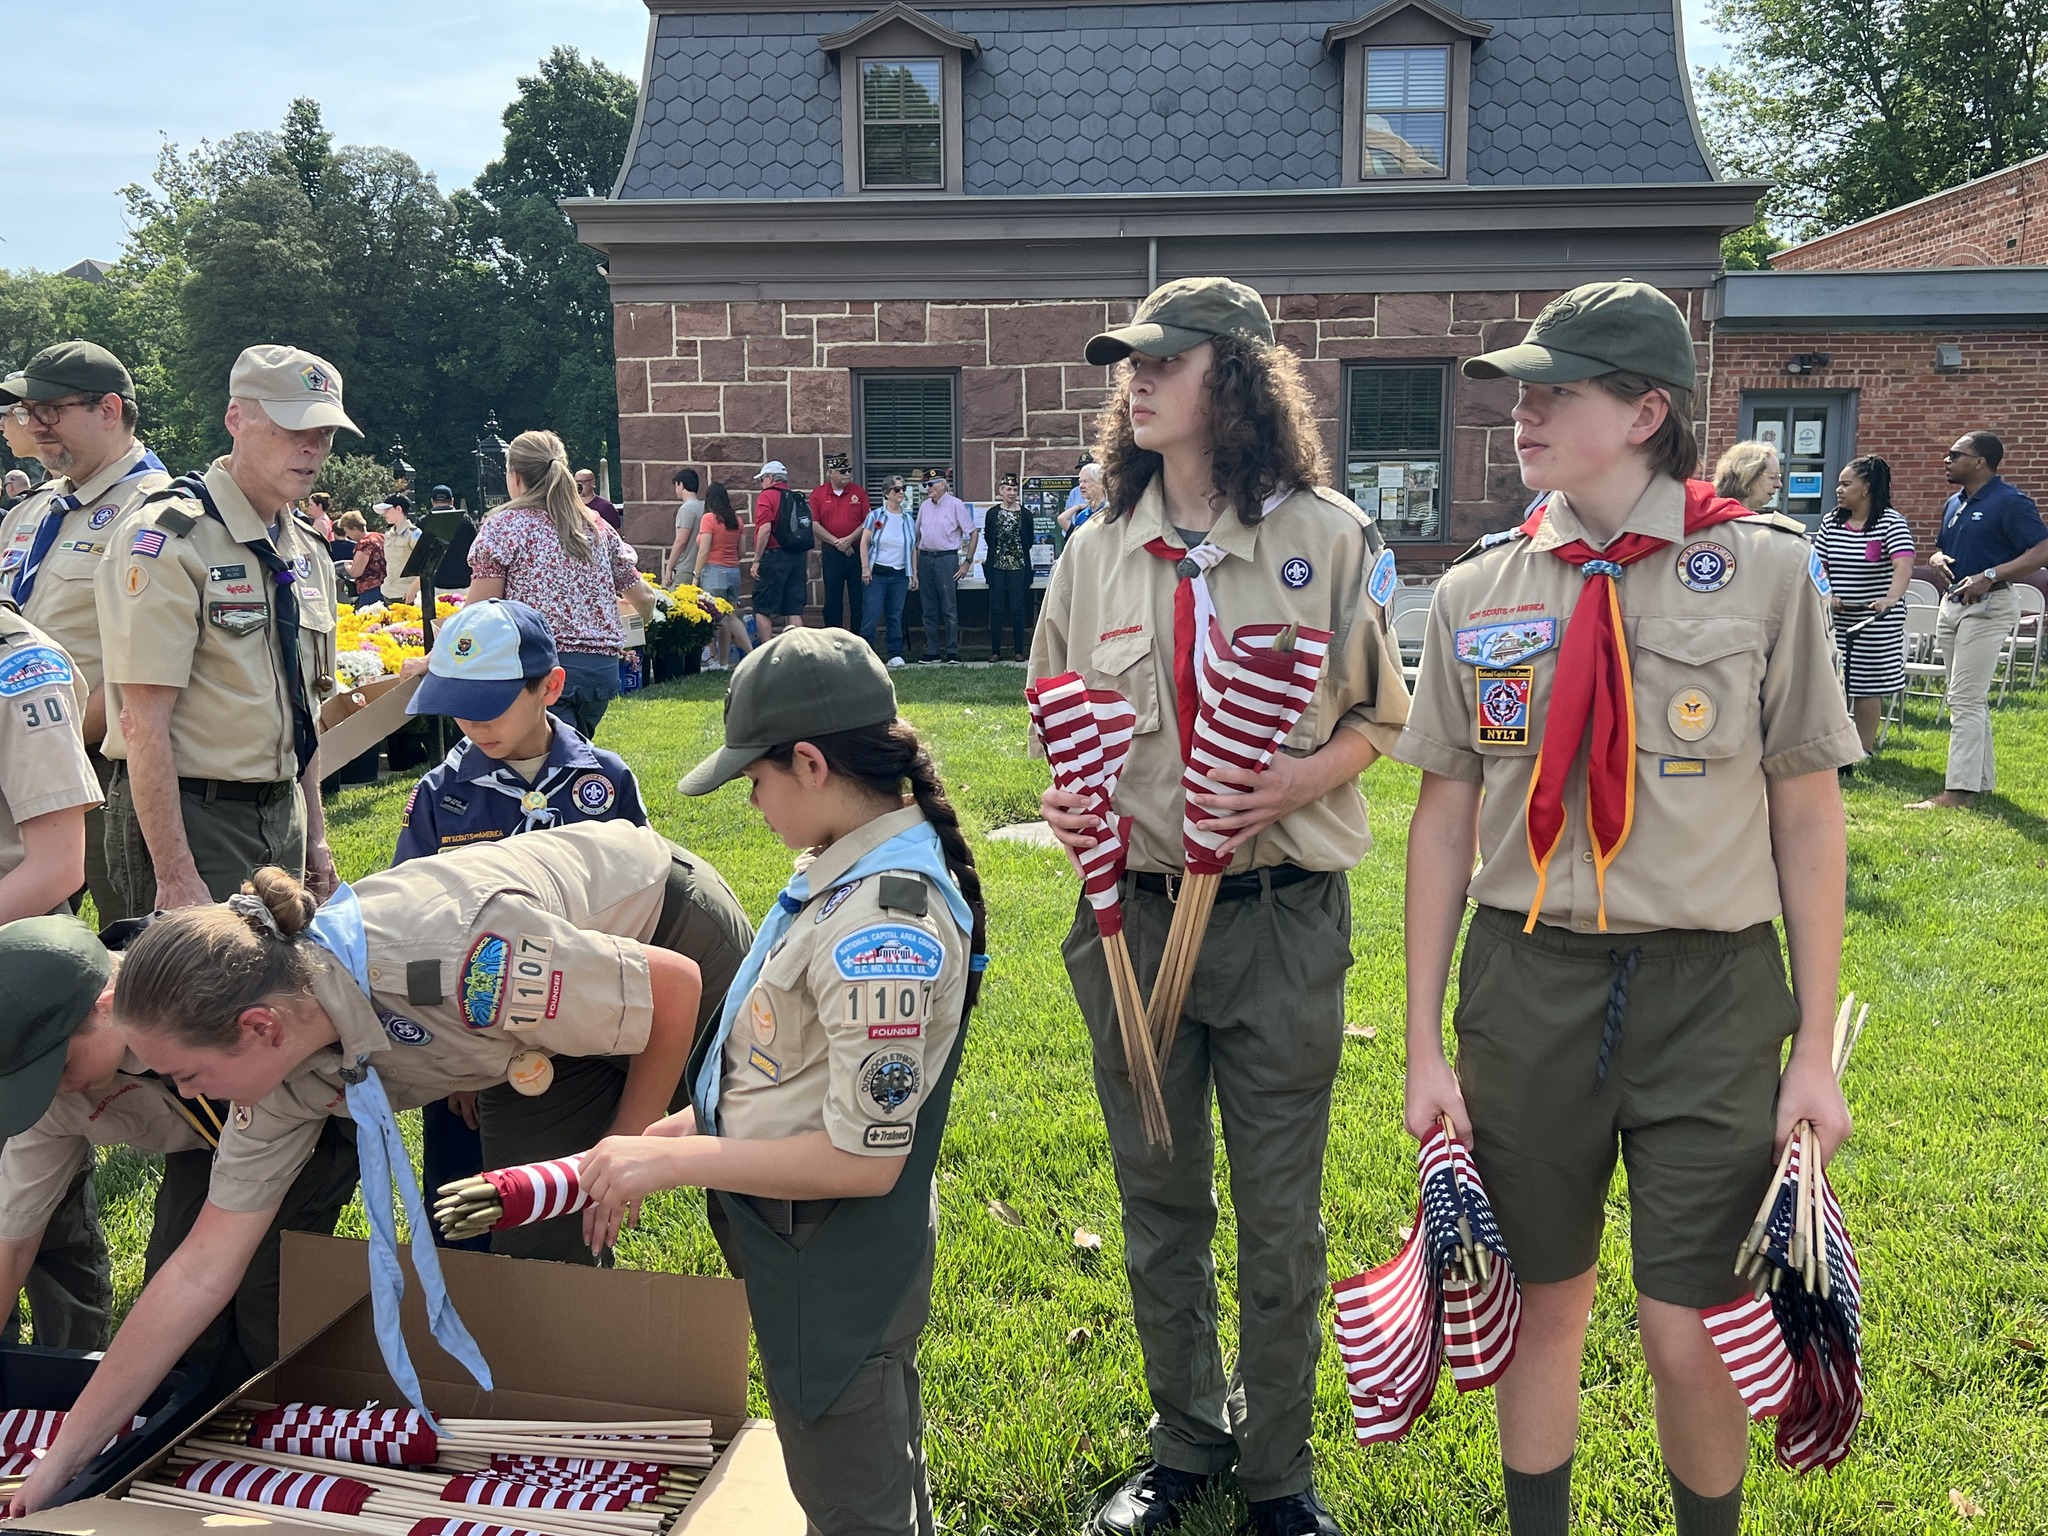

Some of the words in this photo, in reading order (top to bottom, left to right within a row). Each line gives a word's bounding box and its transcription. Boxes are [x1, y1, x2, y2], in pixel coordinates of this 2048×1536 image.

[236, 584, 254, 594] BSA
[1469, 611, 1481, 620] BOY
[1482, 608, 1508, 617] SCOUTS
[1516, 603, 1545, 613] AMERICA
[14, 653, 37, 664] CAPITAL
[22, 697, 62, 727] 30
[1487, 729, 1517, 740] NYLT
[452, 833, 474, 843] SCOUTS
[479, 829, 504, 839] AMERICA
[470, 936, 492, 963] COUNCIL
[838, 936, 870, 956] NATIONAL
[871, 931, 898, 940] CAPITAL
[900, 932, 917, 942] AREA
[918, 936, 940, 956] COUNCIL
[854, 965, 869, 974] D.C.
[871, 964, 885, 973] MD.
[510, 939, 547, 1025] 1107
[549, 974, 561, 1017] FOUNDER
[848, 985, 931, 1020] 1107
[463, 998, 475, 1022] ALOHA
[872, 1027, 918, 1037] FOUNDER
[861, 1055, 888, 1093] OUTDOOR
[889, 1053, 916, 1067] ETHICS
[912, 1067, 920, 1094] GUIDE
[880, 1129, 909, 1141] Trained
